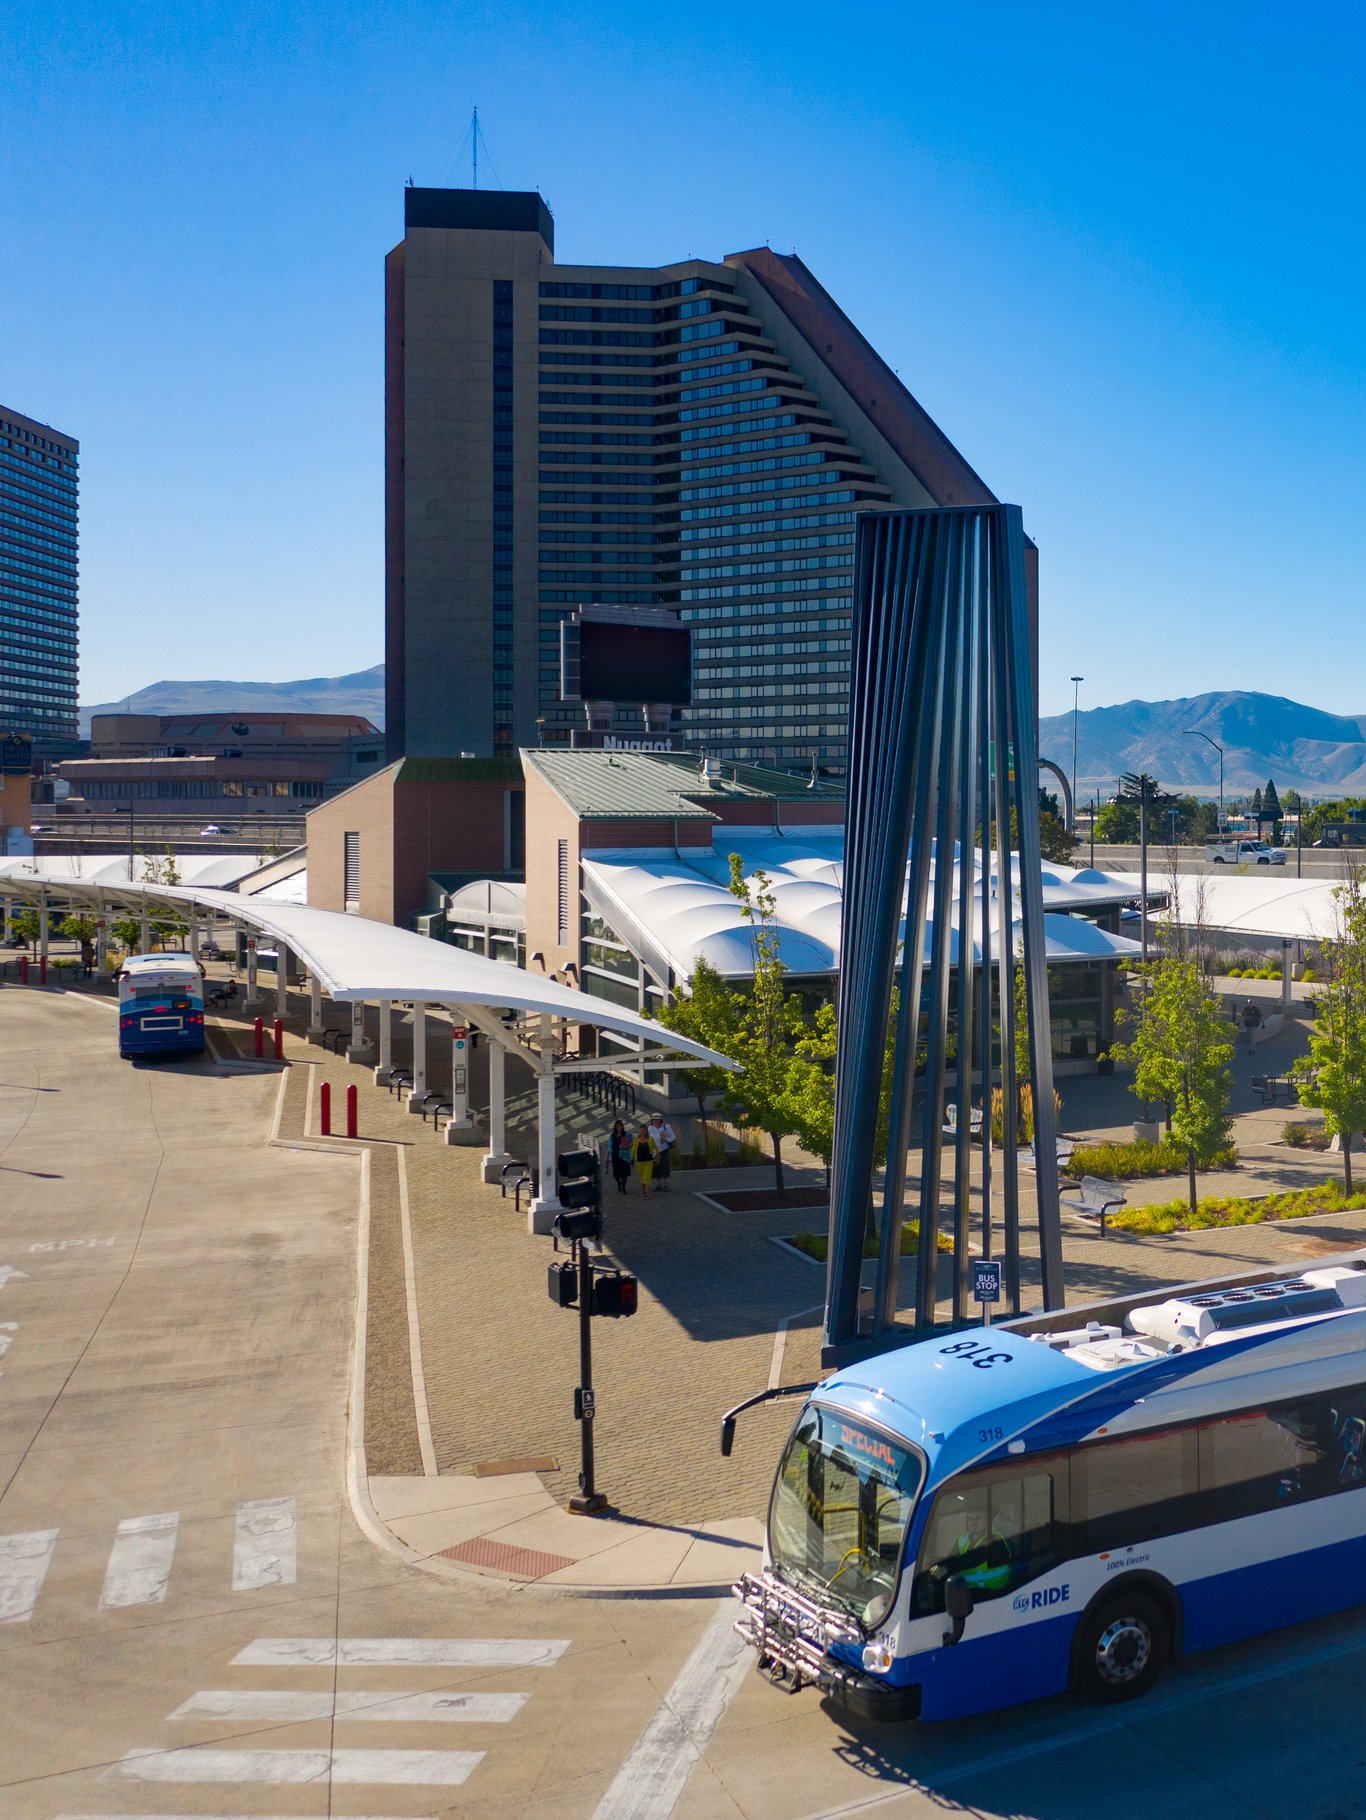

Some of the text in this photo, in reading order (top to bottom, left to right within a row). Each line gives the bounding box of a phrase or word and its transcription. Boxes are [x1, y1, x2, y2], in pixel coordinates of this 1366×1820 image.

[28, 1236, 116, 1252] MPH
[975, 1282, 998, 1290] STOP
[978, 1274, 995, 1282] BUS
[939, 1341, 1014, 1369] 318
[978, 1426, 1004, 1443] 318
[841, 1424, 896, 1466] SPECIAL
[1106, 1552, 1151, 1571] 100% Electric
[1031, 1583, 1070, 1610] RIDE
[878, 1631, 896, 1649] 318
